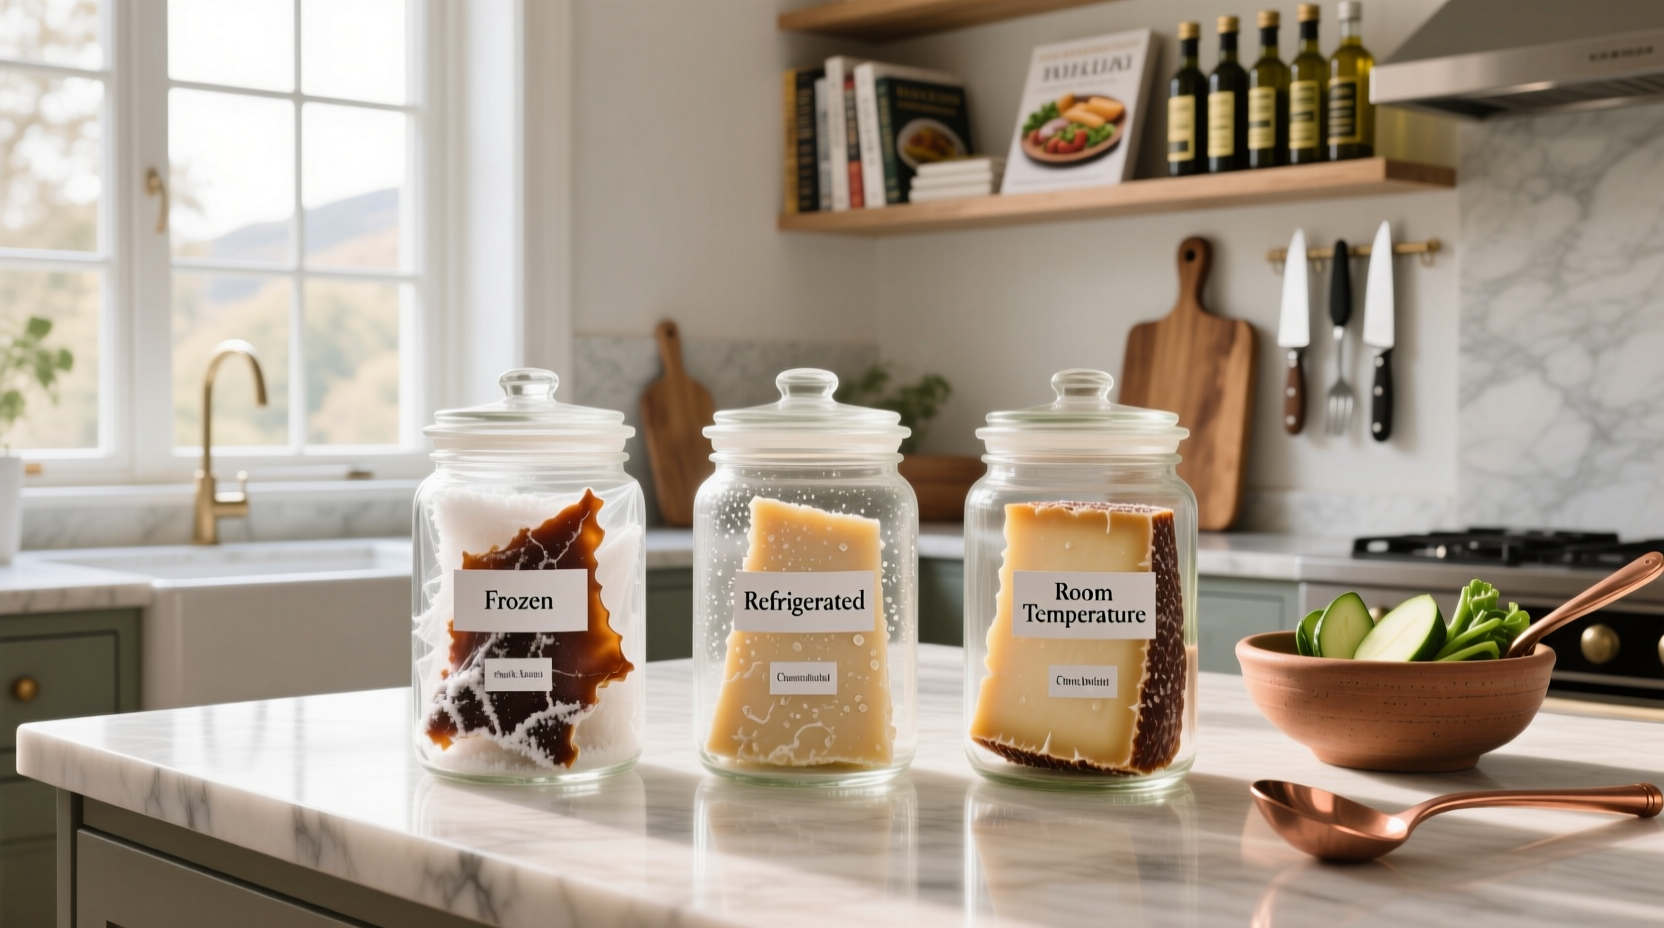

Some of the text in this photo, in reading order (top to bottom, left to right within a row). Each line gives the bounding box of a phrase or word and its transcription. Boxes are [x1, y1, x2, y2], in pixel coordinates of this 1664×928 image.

[484, 590, 554, 610] Frozen
[744, 589, 866, 617] Refrigerated
[1055, 582, 1113, 601] Room
[1022, 603, 1147, 629] Temperature
